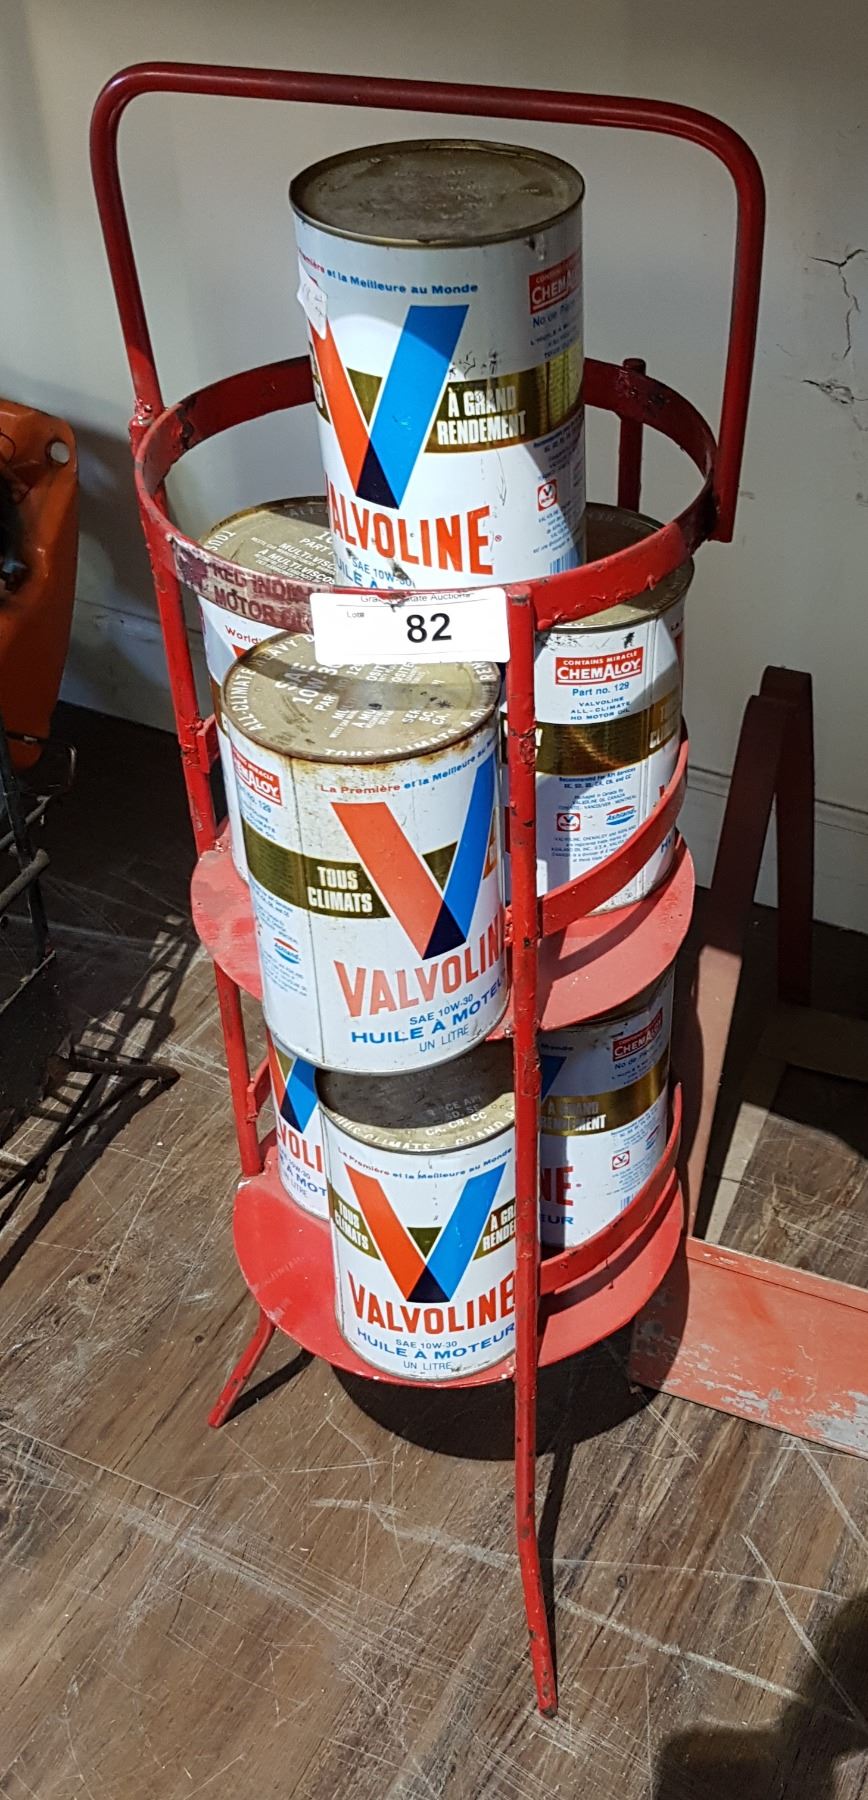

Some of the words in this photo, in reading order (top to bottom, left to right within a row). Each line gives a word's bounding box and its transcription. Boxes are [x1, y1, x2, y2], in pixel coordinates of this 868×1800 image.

[326, 268, 337, 280] et
[338, 271, 347, 283] la
[350, 275, 407, 294] Meilleure
[411, 283, 428, 294] au
[432, 283, 478, 295] Monde
[448, 387, 460, 418] À
[463, 386, 516, 417] GRAND
[436, 410, 526, 446] RENDEMENT
[325, 474, 493, 575] ALVOLINE
[352, 557, 371, 573] SAE
[214, 585, 276, 623] MOTOR
[406, 613, 452, 644] 82
[563, 658, 604, 666] CONTAINS
[606, 650, 638, 663] MIRACLE
[572, 688, 593, 697] Part
[596, 687, 611, 695] no.
[614, 682, 630, 692] 129
[579, 696, 624, 708] VALVOLINE
[586, 711, 615, 720] MOTOR
[320, 785, 337, 794] La
[341, 784, 400, 794] Première
[404, 782, 416, 790] et
[418, 777, 430, 786] la
[432, 757, 476, 782] Meilleure
[317, 866, 358, 890] TOUS
[307, 887, 373, 913] CLIMATS
[333, 924, 500, 1018] VALVOLIN
[409, 1012, 435, 1026] SAE
[438, 993, 474, 1017] 10W-30
[351, 1026, 424, 1044] HUILE
[431, 1018, 446, 1034] À
[419, 1039, 435, 1052] UN
[441, 1023, 469, 1046] LITRE
[471, 1112, 488, 1123] CC
[337, 1147, 347, 1155] La
[349, 1154, 390, 1176] Première
[392, 1170, 403, 1179] et
[405, 1172, 415, 1180] la
[417, 1169, 466, 1180] Meilleure
[468, 1164, 481, 1173] au
[483, 1147, 512, 1167] Monde
[334, 1209, 369, 1250] CLIMATS
[338, 1200, 360, 1230] TOUS
[348, 1270, 515, 1335] VALVOLINE
[357, 1327, 407, 1358] HUILE
[414, 1347, 427, 1360] À
[434, 1322, 515, 1360] MOTEUR
[395, 1338, 417, 1349] SAE
[420, 1340, 458, 1350] 10W-30
[403, 1360, 417, 1370] UN
[423, 1361, 452, 1371] LITRE
